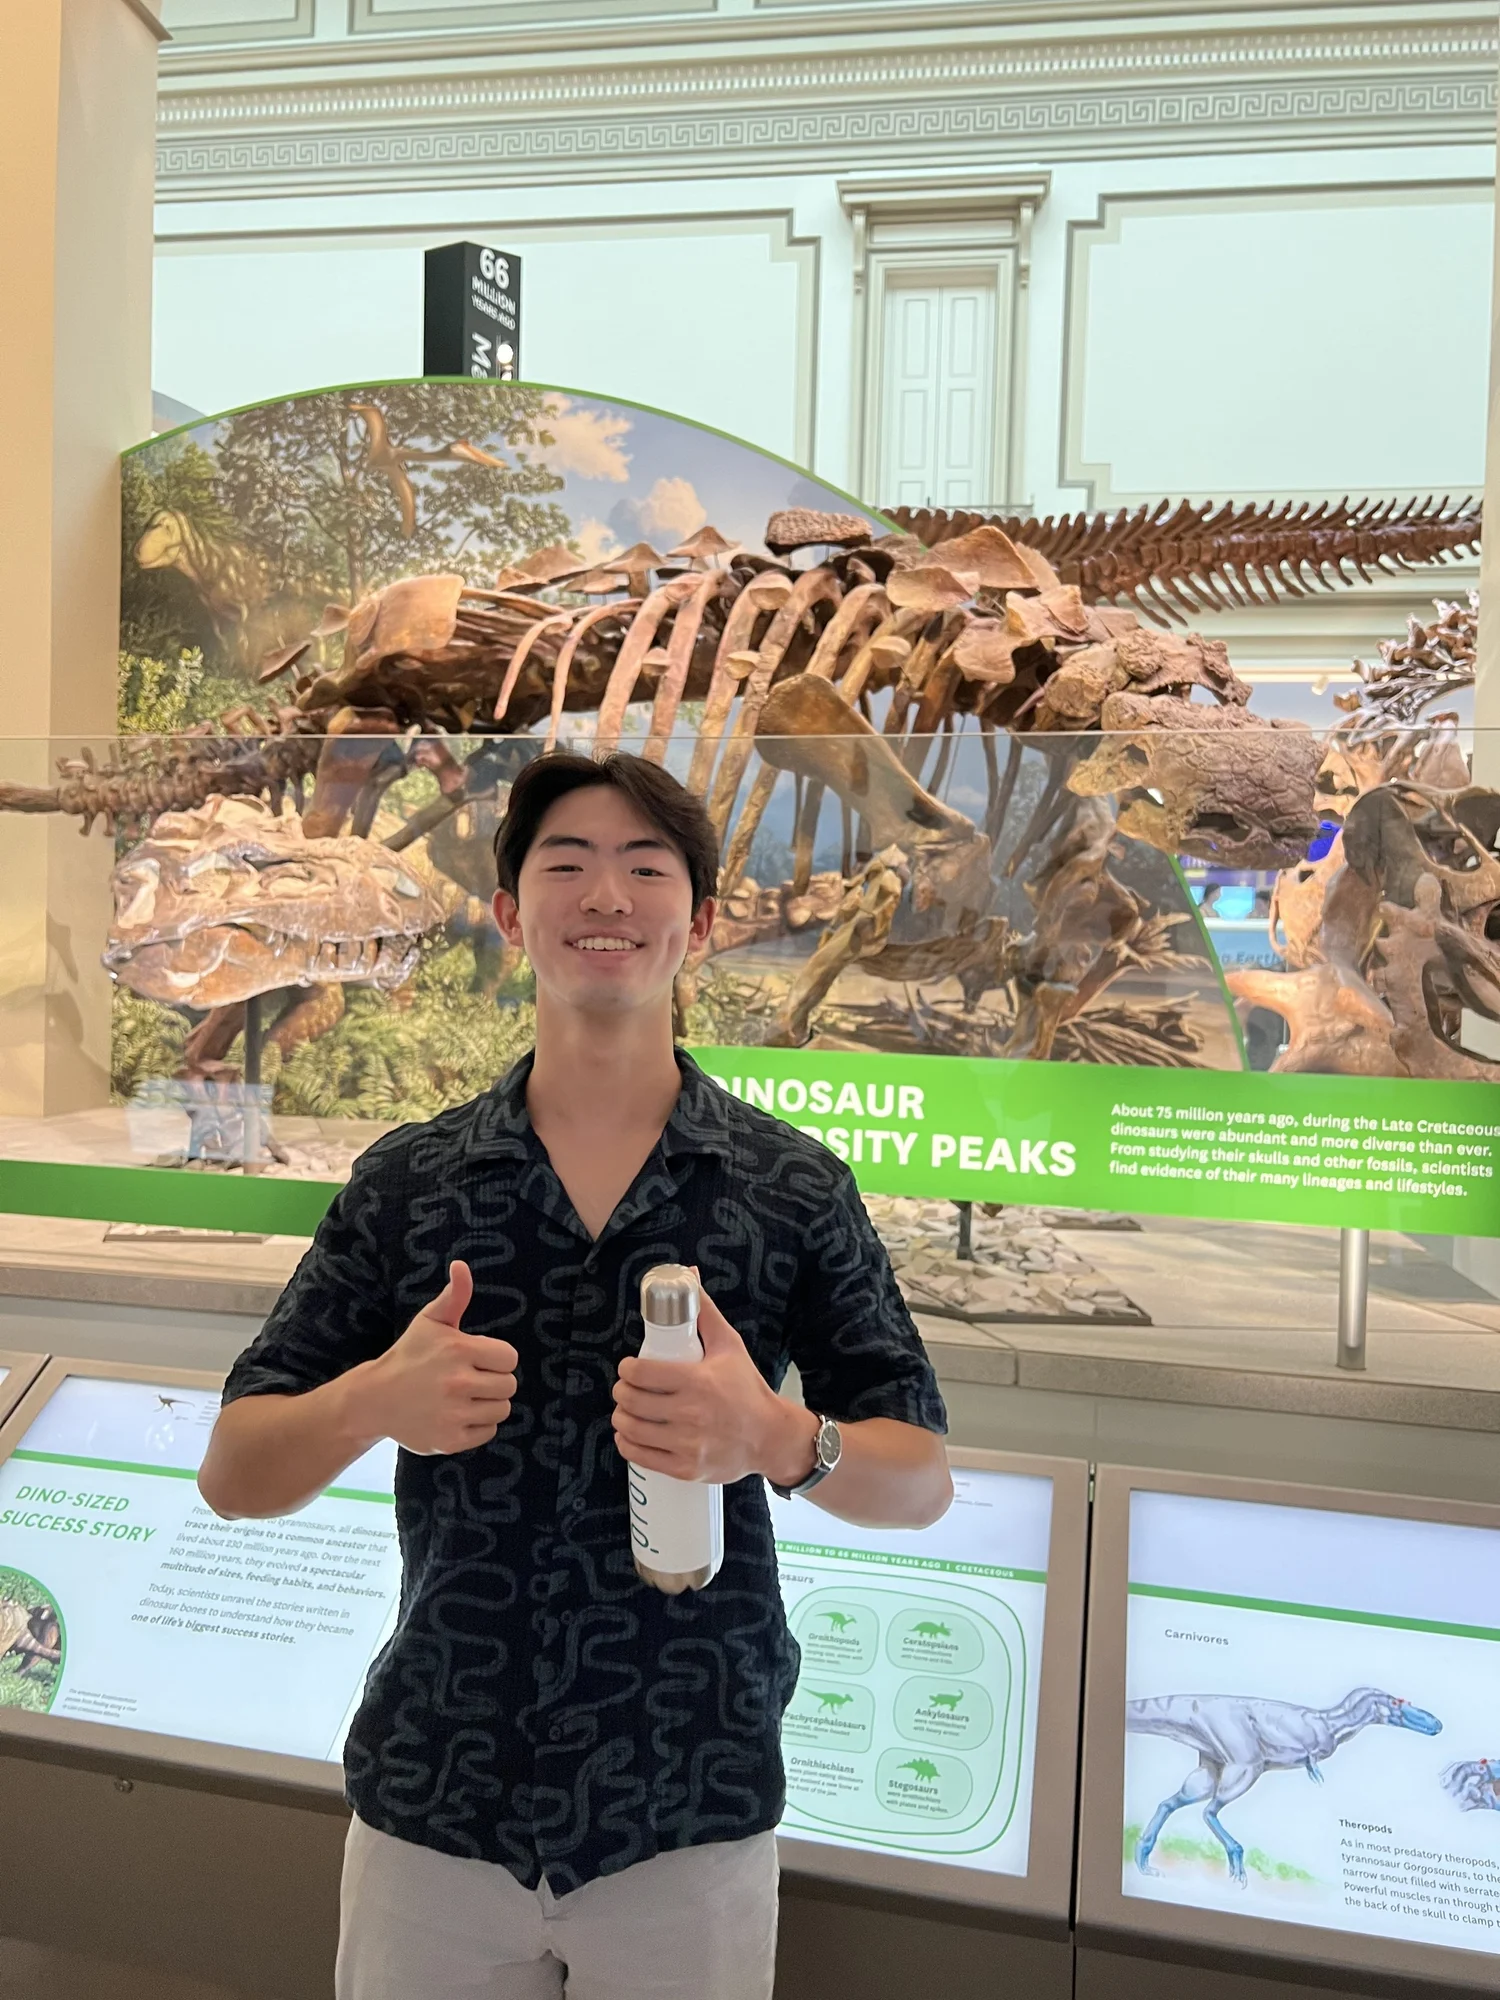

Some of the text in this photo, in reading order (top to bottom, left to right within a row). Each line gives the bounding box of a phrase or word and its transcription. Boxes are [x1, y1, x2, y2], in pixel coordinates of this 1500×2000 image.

[480, 248, 510, 290] 66
[471, 275, 516, 316] MILLION
[471, 294, 516, 331] YEARS AGO
[1111, 1103, 1500, 1137] About 75 million years ago, during the Late Cretaceous
[1111, 1121, 1493, 1157] dinosaurs were abundant and more diverse than ever.
[930, 1134, 1077, 1178] PEAKS
[1110, 1142, 1493, 1177] From studying their skulls and other fossils, scientists
[1109, 1160, 1468, 1198] find evidence of their many lineages and lifestyles.
[15, 1485, 130, 1512] DINO-SIZED
[0, 1509, 157, 1542] SUCCESS STORY
[184, 1519, 209, 1531] trace
[210, 1521, 232, 1534] their
[233, 1525, 265, 1538] origins
[265, 1530, 276, 1539] to
[285, 1533, 325, 1545] common
[325, 1537, 367, 1551] ancestor
[367, 1541, 388, 1554] that
[351, 1526, 397, 1540] dinosaurs
[176, 1532, 198, 1544] lived
[198, 1536, 224, 1547] about
[242, 1541, 274, 1554] million
[273, 1547, 299, 1558] years
[321, 1552, 343, 1563] Over
[344, 1554, 359, 1565] the
[360, 1557, 381, 1568] next
[185, 1549, 216, 1561] million
[217, 1555, 243, 1565] years,
[245, 1557, 265, 1570] they
[266, 1561, 303, 1573] evolved
[301, 1565, 308, 1573] a
[309, 1565, 367, 1581] spectacular
[785, 1543, 822, 1555] MILLION
[824, 1548, 836, 1556] TO
[851, 1551, 889, 1563] MILLION
[890, 1555, 919, 1567] YEARS
[920, 1559, 941, 1569] AGO
[955, 1563, 1015, 1578] CRETACEOUS
[160, 1561, 386, 1599] multitude of sizes, feeding habits, and behaviors.
[780, 1573, 815, 1584] osaurs
[139, 1597, 355, 1636] dinosaur bones to understand how they became
[148, 1582, 350, 1619] Today, scientists unravel the stories written in
[131, 1613, 296, 1644] one of life's biggest success stories.
[1164, 1628, 1229, 1646] Carnivores
[914, 1708, 970, 1723] Ankylosaurs
[790, 1757, 855, 1774] Ornithischians
[888, 1779, 938, 1795] Stegosaurs
[1338, 1819, 1393, 1834] Theropods
[1340, 1838, 1500, 1870] As in most predatory theropods,
[1341, 1853, 1500, 1884] tyrannosaur Gorgosaurus, to the
[1343, 1868, 1378, 1880] narrow
[1380, 1872, 1409, 1885] snout
[1410, 1876, 1437, 1889] filled
[1438, 1881, 1461, 1893] with
[1343, 1881, 1388, 1897] Powerful
[1390, 1889, 1431, 1903] muscles
[1433, 1896, 1451, 1905] ran
[1452, 1898, 1493, 1913] through
[1344, 1896, 1362, 1907] the
[1364, 1898, 1388, 1911] back
[1390, 1903, 1401, 1913] of
[1403, 1905, 1420, 1915] the
[1422, 1908, 1447, 1920] skull
[1448, 1912, 1460, 1922] to
[1462, 1913, 1494, 1928] clamp
